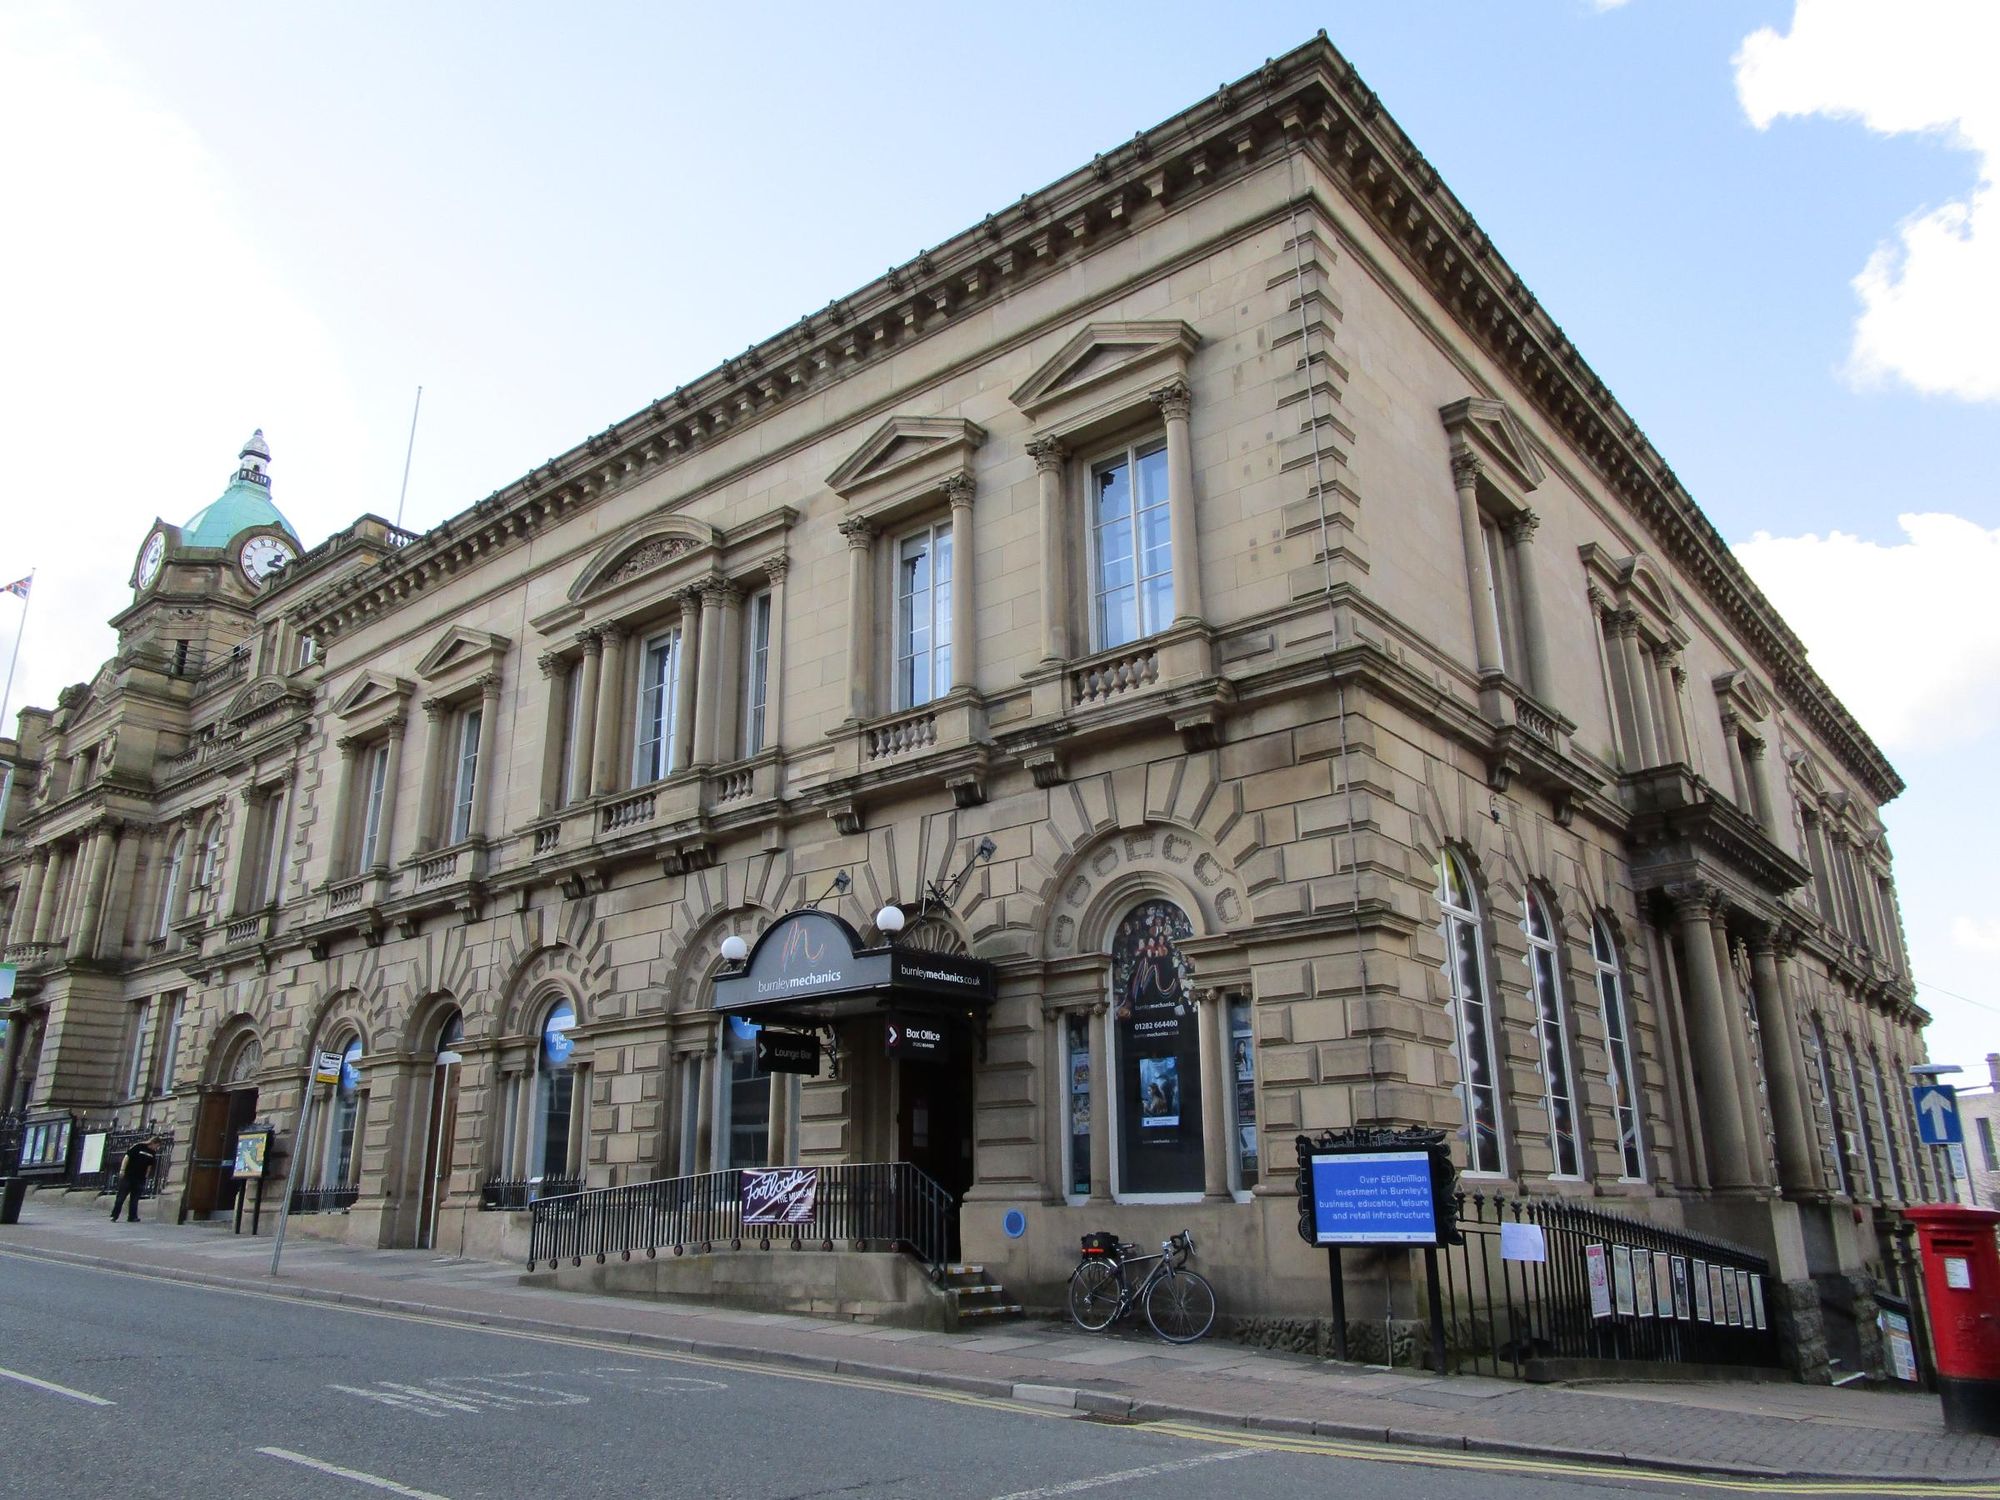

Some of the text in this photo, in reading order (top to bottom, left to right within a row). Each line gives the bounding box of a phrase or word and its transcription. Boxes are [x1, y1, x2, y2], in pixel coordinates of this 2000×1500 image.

[901, 964, 981, 986] burnleymechanics.co.uk
[758, 970, 841, 993] burnleymechanics
[1134, 1020, 1178, 1030] 01282 664400
[906, 1028, 940, 1042] Box Office
[774, 1047, 812, 1061] Lounge Bar
[1359, 1175, 1379, 1184] Over
[744, 1170, 803, 1209] Footloose
[1390, 1187, 1428, 1196] Burnley's
[1319, 1199, 1430, 1209] business, education, leisure
[1332, 1210, 1431, 1220] and retail infrastructure
